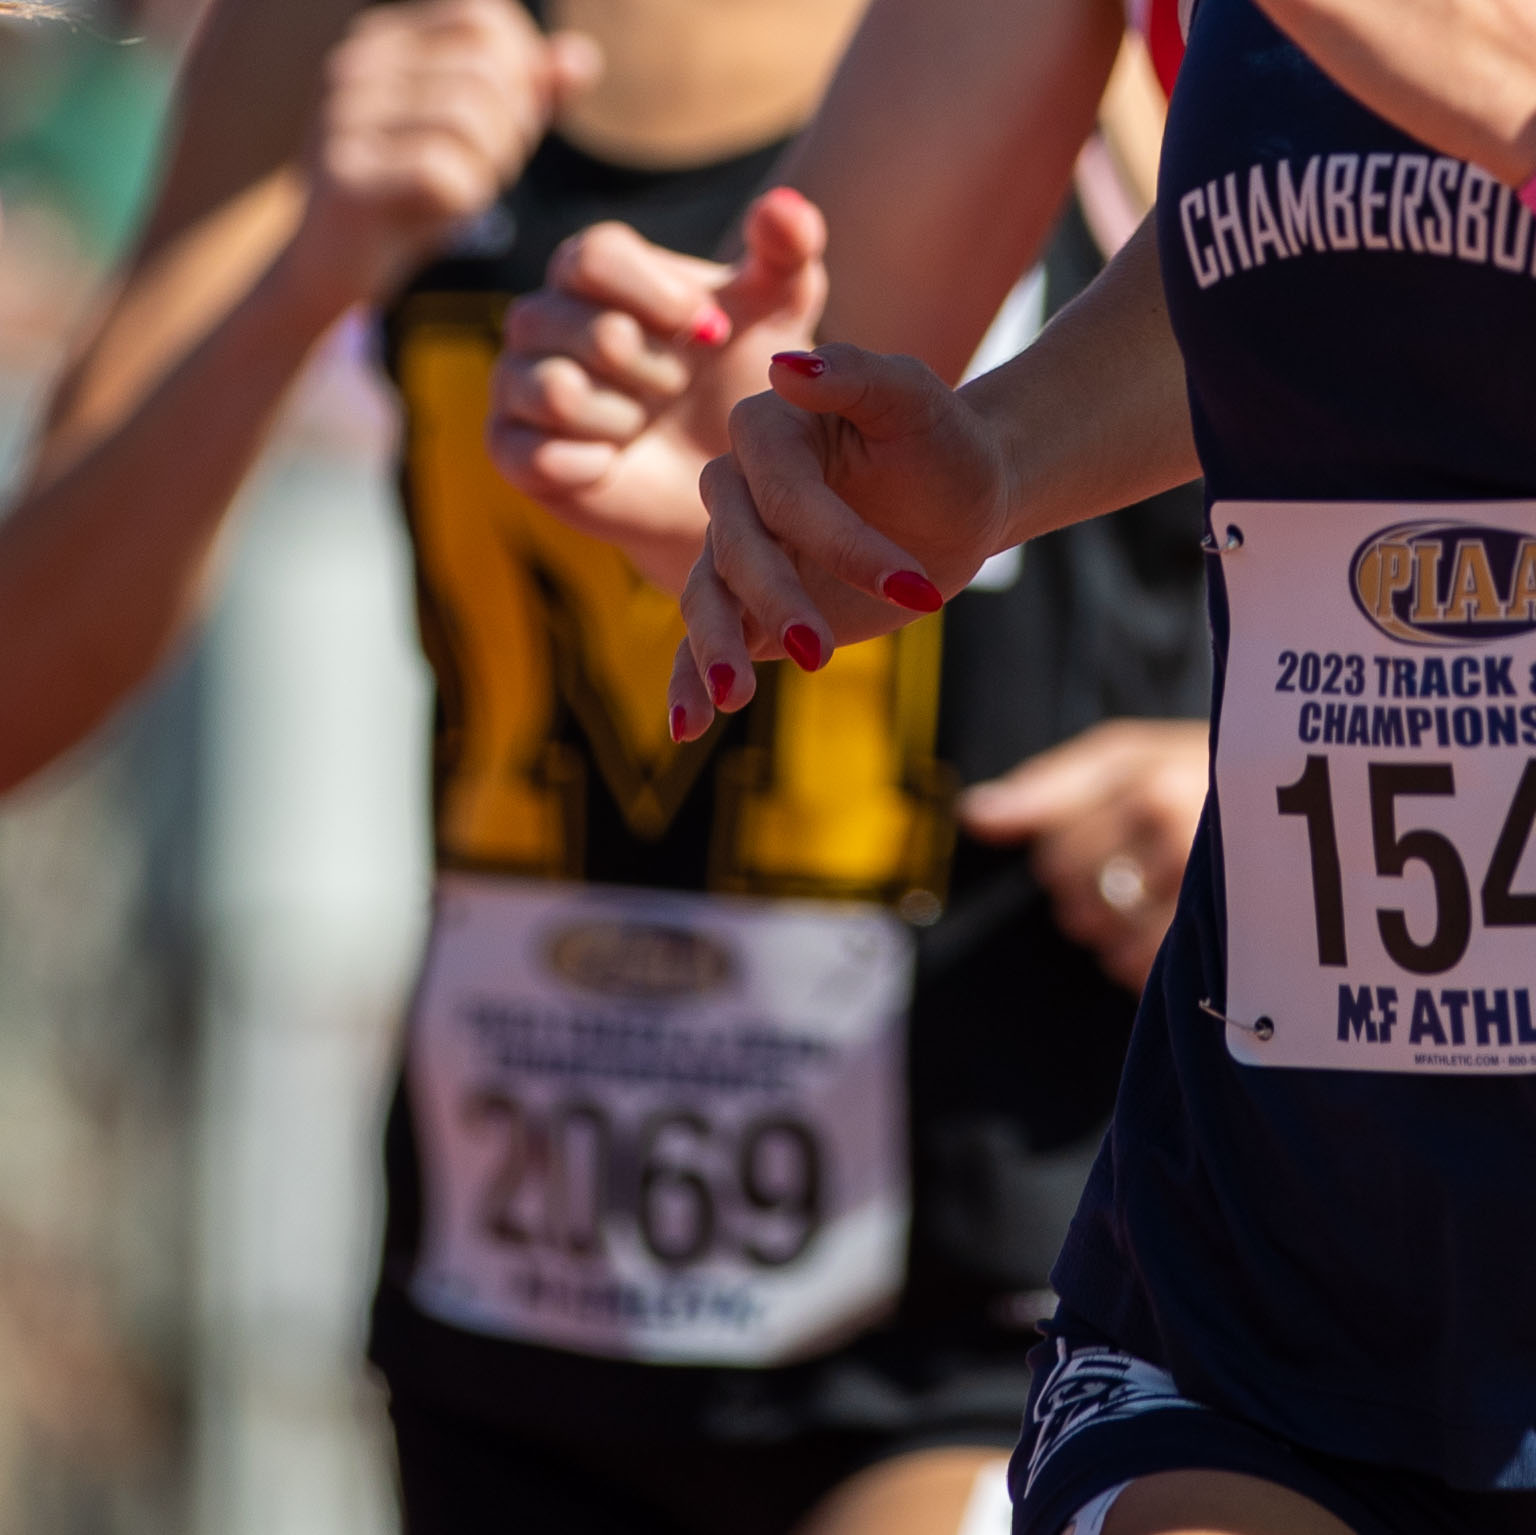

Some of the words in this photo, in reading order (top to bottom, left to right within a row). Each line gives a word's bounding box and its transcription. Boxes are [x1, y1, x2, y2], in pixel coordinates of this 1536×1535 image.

[1274, 650, 1365, 696] 2023
[1373, 654, 1518, 698] TRACK
[461, 1088, 825, 1272] 2069
